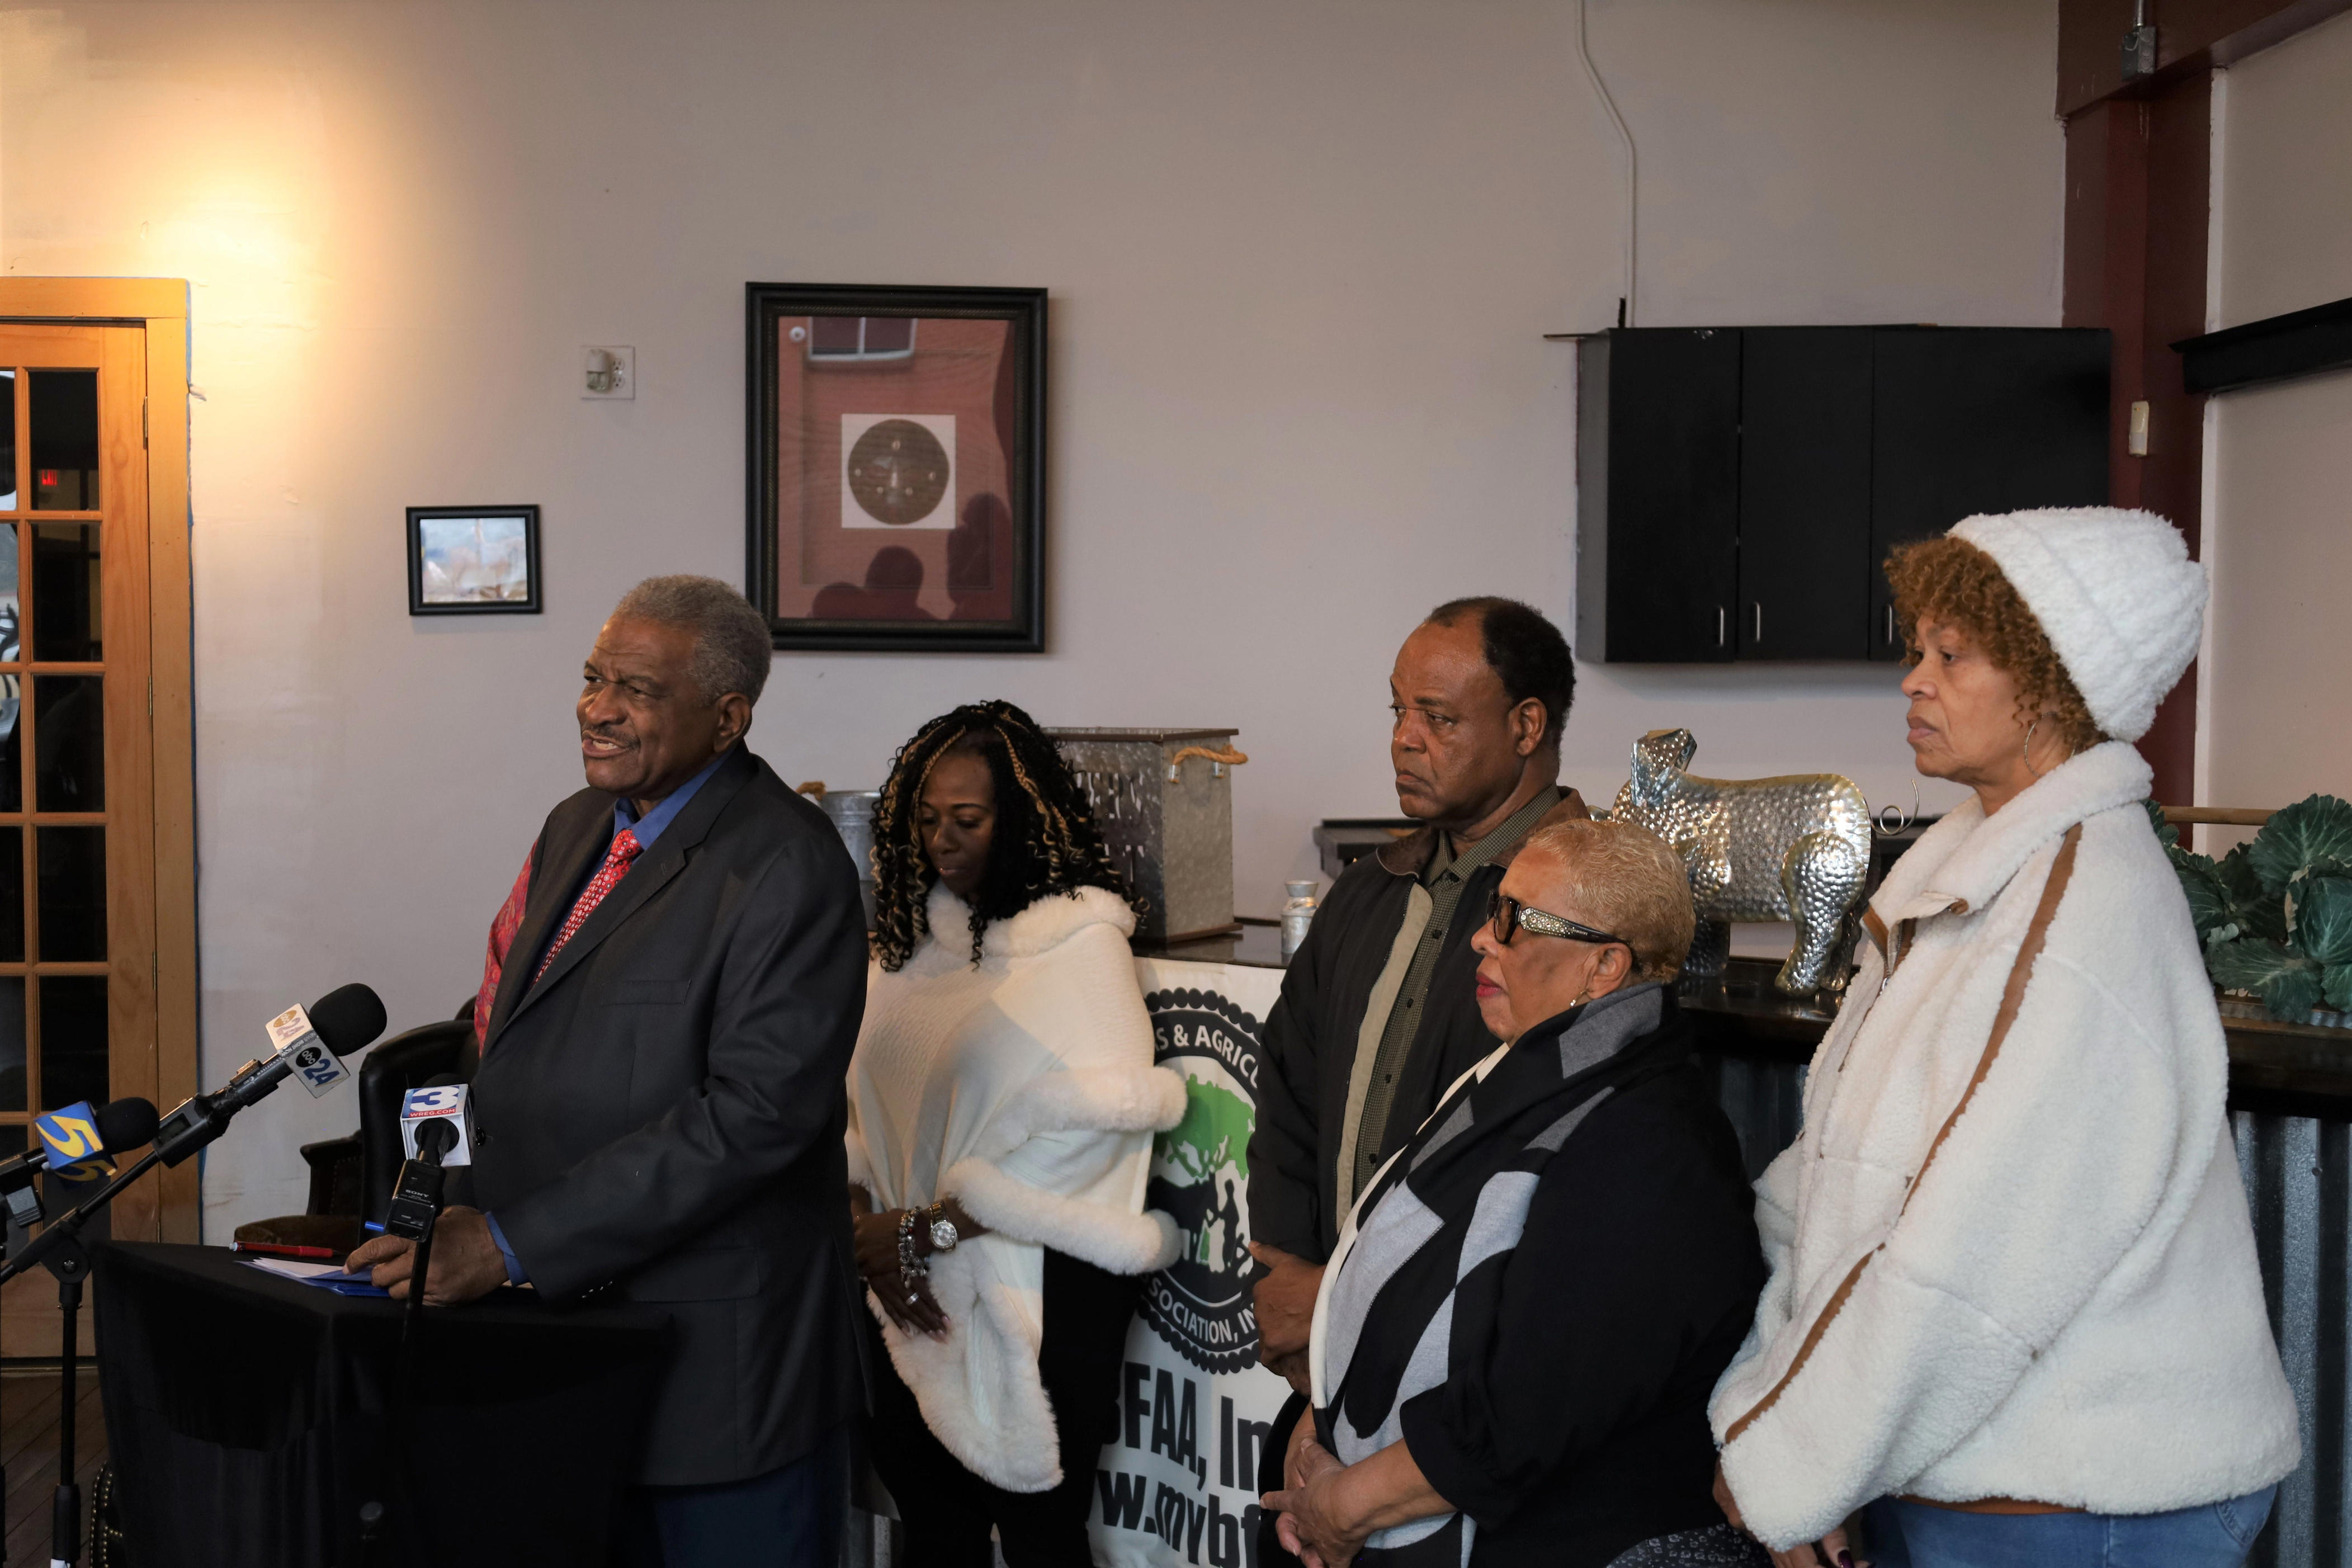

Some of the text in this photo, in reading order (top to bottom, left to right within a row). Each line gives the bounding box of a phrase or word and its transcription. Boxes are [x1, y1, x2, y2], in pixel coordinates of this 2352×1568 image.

[1174, 1024, 1189, 1047] &
[301, 1050, 339, 1088] abc 24
[410, 1086, 460, 1112] 3
[410, 1108, 456, 1117] WREG.COM
[36, 1115, 103, 1158] 5
[55, 1159, 116, 1181] 5
[405, 1189, 429, 1198] SONY
